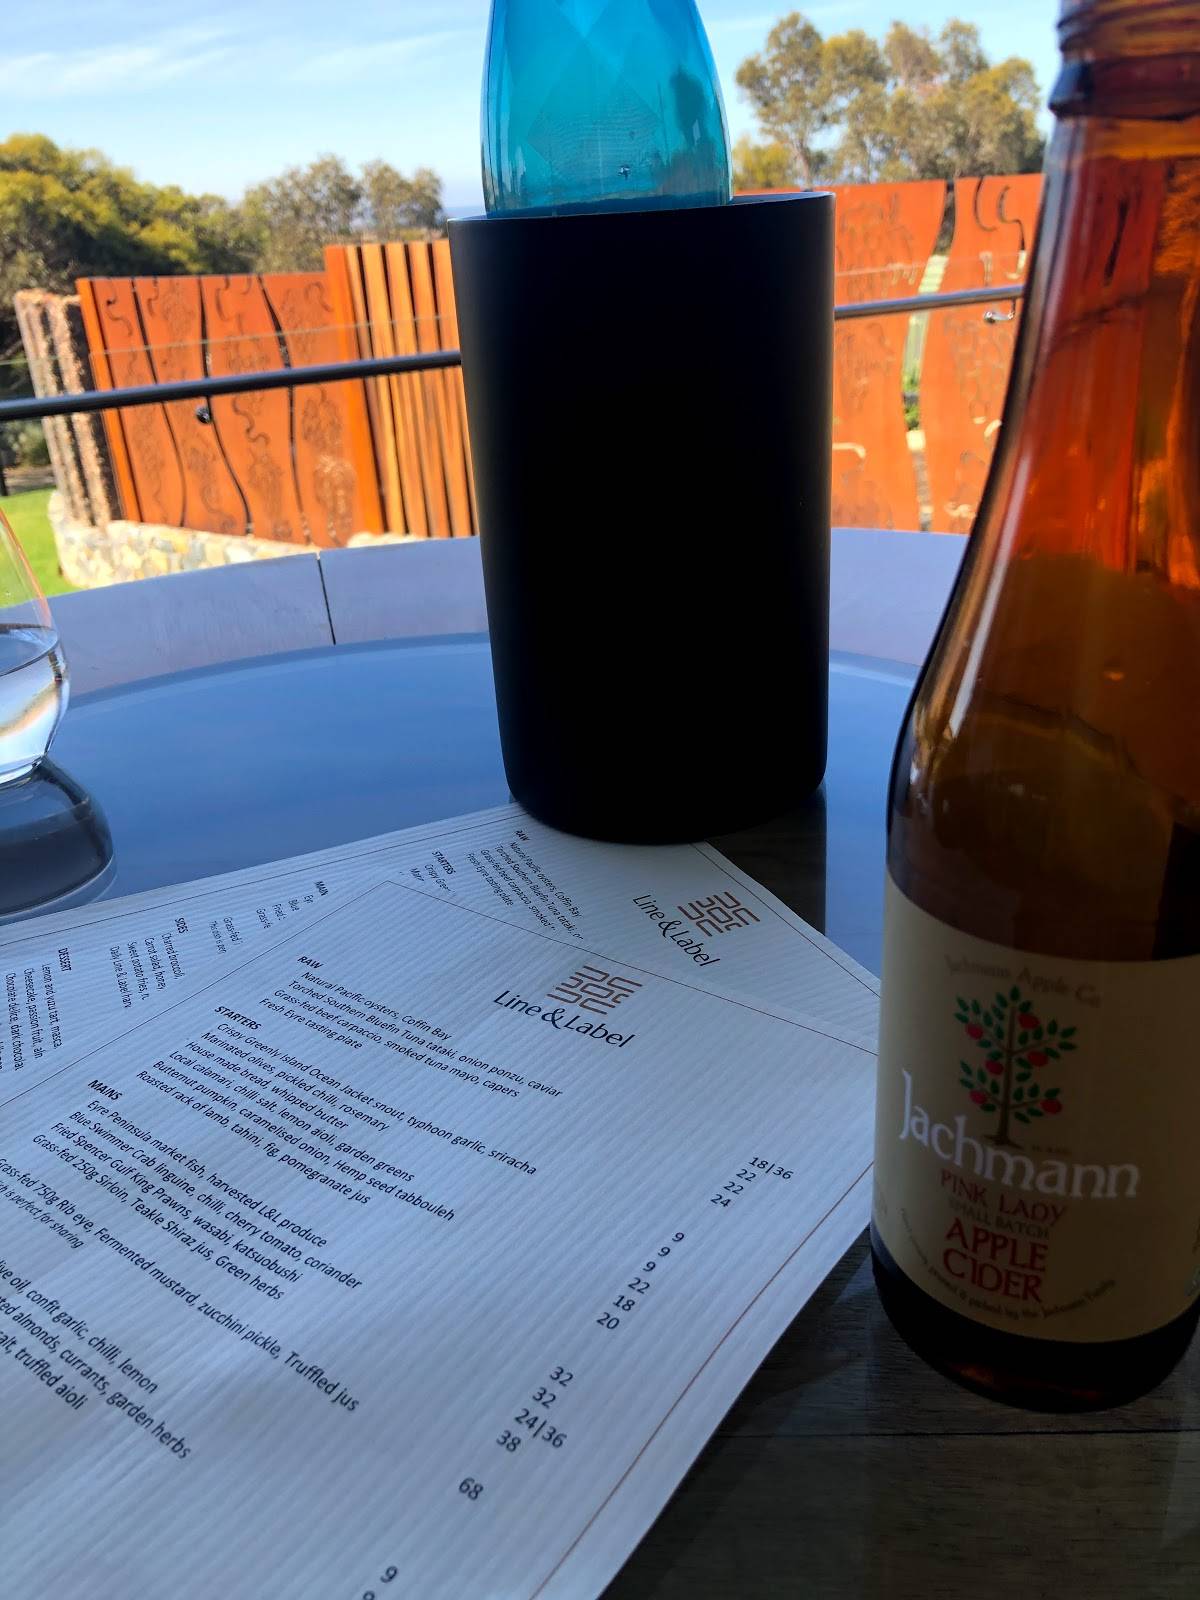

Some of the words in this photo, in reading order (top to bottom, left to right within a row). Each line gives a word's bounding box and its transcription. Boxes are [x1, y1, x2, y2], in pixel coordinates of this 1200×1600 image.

[632, 894, 666, 921] Line
[669, 930, 721, 967] Label
[58, 947, 72, 972] DESSERT
[296, 955, 324, 969] RAW
[213, 1005, 262, 1030] STARTERS
[258, 998, 285, 1013] Fresh
[283, 1009, 306, 1023] Eyre
[304, 1019, 338, 1039] tasting
[333, 1034, 363, 1049] plate
[300, 971, 338, 990] Natural
[334, 986, 365, 1003] Pacific
[363, 1000, 399, 1020] oysters,
[401, 1015, 431, 1032] Coffin
[430, 1027, 452, 1041] Bay
[493, 990, 543, 1017] Line
[564, 1015, 636, 1048] Label
[273, 989, 319, 1012] Grass-fed
[314, 1007, 342, 1021] beef
[336, 1019, 382, 1044] carpaccio,
[383, 1040, 427, 1061] smoked
[423, 1057, 449, 1071] tuna
[448, 1067, 479, 1085] mayo,
[482, 1080, 520, 1097] capers
[288, 980, 327, 1000] Torched
[322, 996, 366, 1019] Southern
[365, 1014, 400, 1034] Bluefin
[400, 1029, 426, 1045] Tuna
[425, 1041, 458, 1059] tataki,
[458, 1055, 490, 1070] onion
[486, 1066, 524, 1085] ponzu,
[527, 1080, 563, 1097] caviar
[88, 1079, 122, 1100] MAINS
[184, 1041, 215, 1059] House
[212, 1056, 241, 1073] made
[239, 1068, 272, 1090] bread,
[270, 1085, 318, 1112] whipped
[313, 1107, 349, 1129] butter
[200, 1031, 252, 1059] Marinated
[246, 1056, 276, 1075] olives,
[273, 1070, 316, 1092] pickled
[311, 1089, 338, 1107] chilli,
[338, 1104, 390, 1132] rosemary
[216, 1023, 246, 1040] Crispy
[244, 1036, 282, 1058] Greenly
[279, 1053, 313, 1072] Island
[308, 1068, 341, 1089] Ocean
[338, 1084, 374, 1105] Jacket
[371, 1101, 405, 1121] snout,
[406, 1115, 453, 1140] typhoon
[450, 1135, 486, 1155] garlic,
[487, 1150, 537, 1175] sriracha
[135, 1070, 177, 1094] Roasted
[170, 1091, 195, 1106] rack
[191, 1102, 209, 1112] of
[202, 1106, 230, 1128] lamb,
[230, 1123, 264, 1148] tahini,
[262, 1142, 280, 1158] fig,
[277, 1153, 353, 1195] pomegranate
[347, 1189, 371, 1204] jus
[152, 1060, 198, 1087] Butternut
[192, 1084, 238, 1112] pumpkin,
[238, 1108, 303, 1145] caramelised
[297, 1142, 330, 1165] onion,
[332, 1159, 367, 1181] Hemp
[365, 1177, 398, 1194] seed
[394, 1188, 455, 1221] tabbouleh
[168, 1050, 198, 1067] Local
[192, 1064, 235, 1089] calamari,
[233, 1085, 260, 1100] chilli
[255, 1097, 277, 1113] salt,
[277, 1107, 312, 1131] lemon
[310, 1128, 337, 1146] aioli,
[334, 1142, 376, 1165] garden
[372, 1161, 415, 1182] greens
[899, 1069, 1141, 1199] Jachmann
[50, 1122, 79, 1139] Fried
[72, 1135, 113, 1162] Spencer
[109, 1159, 137, 1176] Gulf
[129, 1171, 155, 1194] King
[151, 1187, 192, 1220] Prawns,
[192, 1215, 235, 1246] wasabi,
[232, 1239, 303, 1283] katsuobushi
[68, 1111, 91, 1126] Blue
[88, 1122, 135, 1152] Swimmer
[131, 1149, 157, 1167] Crab
[153, 1162, 196, 1197] linguine,
[196, 1193, 224, 1215] chilli,
[224, 1211, 262, 1236] cherry
[259, 1230, 302, 1262] tomato,
[303, 1256, 363, 1289] coriander
[86, 1100, 110, 1116] Eyre
[106, 1111, 152, 1142] Peninsula
[149, 1139, 187, 1163] market
[183, 1158, 206, 1179] fish,
[205, 1172, 263, 1210] harvested
[257, 1204, 282, 1223] L&L
[276, 1218, 327, 1248] produce
[710, 1193, 731, 1208] 24
[723, 1181, 744, 1195] 22
[735, 1168, 756, 1182] 22
[941, 1168, 987, 1208] PINK
[999, 1194, 1068, 1228] LADY
[32, 1134, 79, 1163] Grass-fed
[71, 1158, 100, 1181] 250g
[94, 1174, 129, 1203] Sirloin,
[130, 1197, 165, 1225] Teakle
[161, 1220, 197, 1247] Shiraz
[189, 1241, 214, 1261] jus,
[214, 1255, 251, 1282] Green
[248, 1275, 284, 1300] herbs
[671, 1231, 685, 1243] 9
[946, 1217, 1049, 1272] APPLE
[995, 1215, 1049, 1241] BATCH
[642, 1261, 656, 1272] 9
[657, 1246, 671, 1257] 9
[943, 1247, 1043, 1304] CIDER
[32, 1183, 60, 1206] 750g
[55, 1199, 76, 1215] Rib
[72, 1213, 94, 1233] eye,
[93, 1227, 156, 1271] Fermented
[148, 1267, 201, 1307] mustard,
[196, 1302, 249, 1335] zucchini
[240, 1330, 281, 1360] pickle,
[284, 1350, 340, 1395] Truffled
[330, 1387, 360, 1412] jus
[612, 1294, 636, 1312] 18
[627, 1276, 650, 1295] 22
[9, 1277, 32, 1295] oil,
[26, 1290, 61, 1315] confit
[52, 1311, 89, 1341] garlic,
[87, 1336, 122, 1365] chilli,
[116, 1357, 158, 1394] lemon
[596, 1311, 620, 1330] 20
[11, 1312, 60, 1354] almonds,
[59, 1349, 110, 1396] currants,
[105, 1391, 154, 1429] garden
[150, 1420, 191, 1459] herbs
[14, 1347, 64, 1387] truffled
[54, 1383, 88, 1410] aioli
[532, 1386, 556, 1409] 32
[549, 1366, 574, 1387] 32
[496, 1429, 521, 1453] 38
[458, 1477, 484, 1501] 68
[380, 1565, 398, 1583] 9
